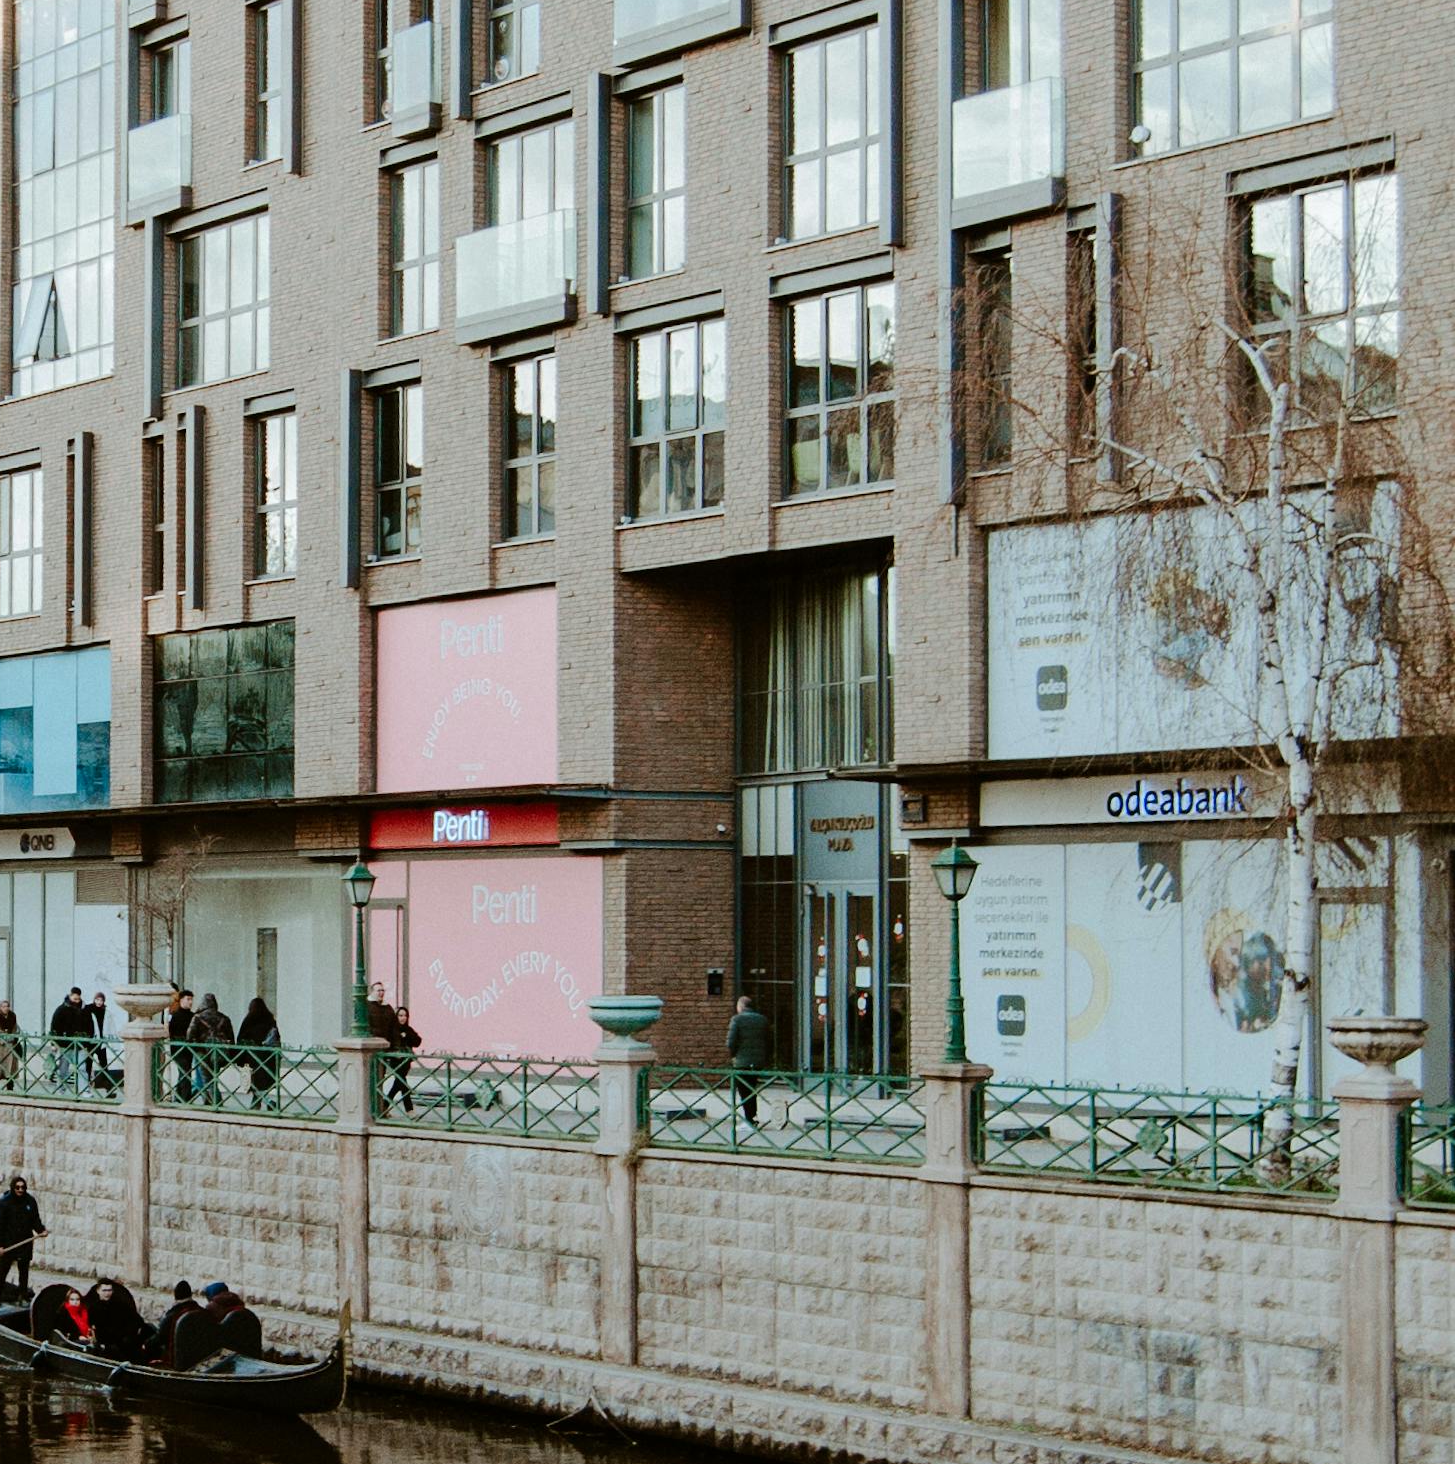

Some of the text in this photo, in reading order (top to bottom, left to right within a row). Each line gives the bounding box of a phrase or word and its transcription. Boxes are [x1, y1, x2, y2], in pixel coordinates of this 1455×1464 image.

[440, 614, 505, 660] Penti
[422, 698, 450, 759] ENJOY
[452, 678, 492, 706] BEING
[1107, 775, 1250, 818] odeabank
[30, 834, 55, 851] QNB
[433, 809, 490, 842] Penti
[471, 885, 539, 924] Penti
[500, 951, 552, 986] EVERY
[979, 947, 1044, 959] merkezinde
[982, 967, 1002, 977] sen
